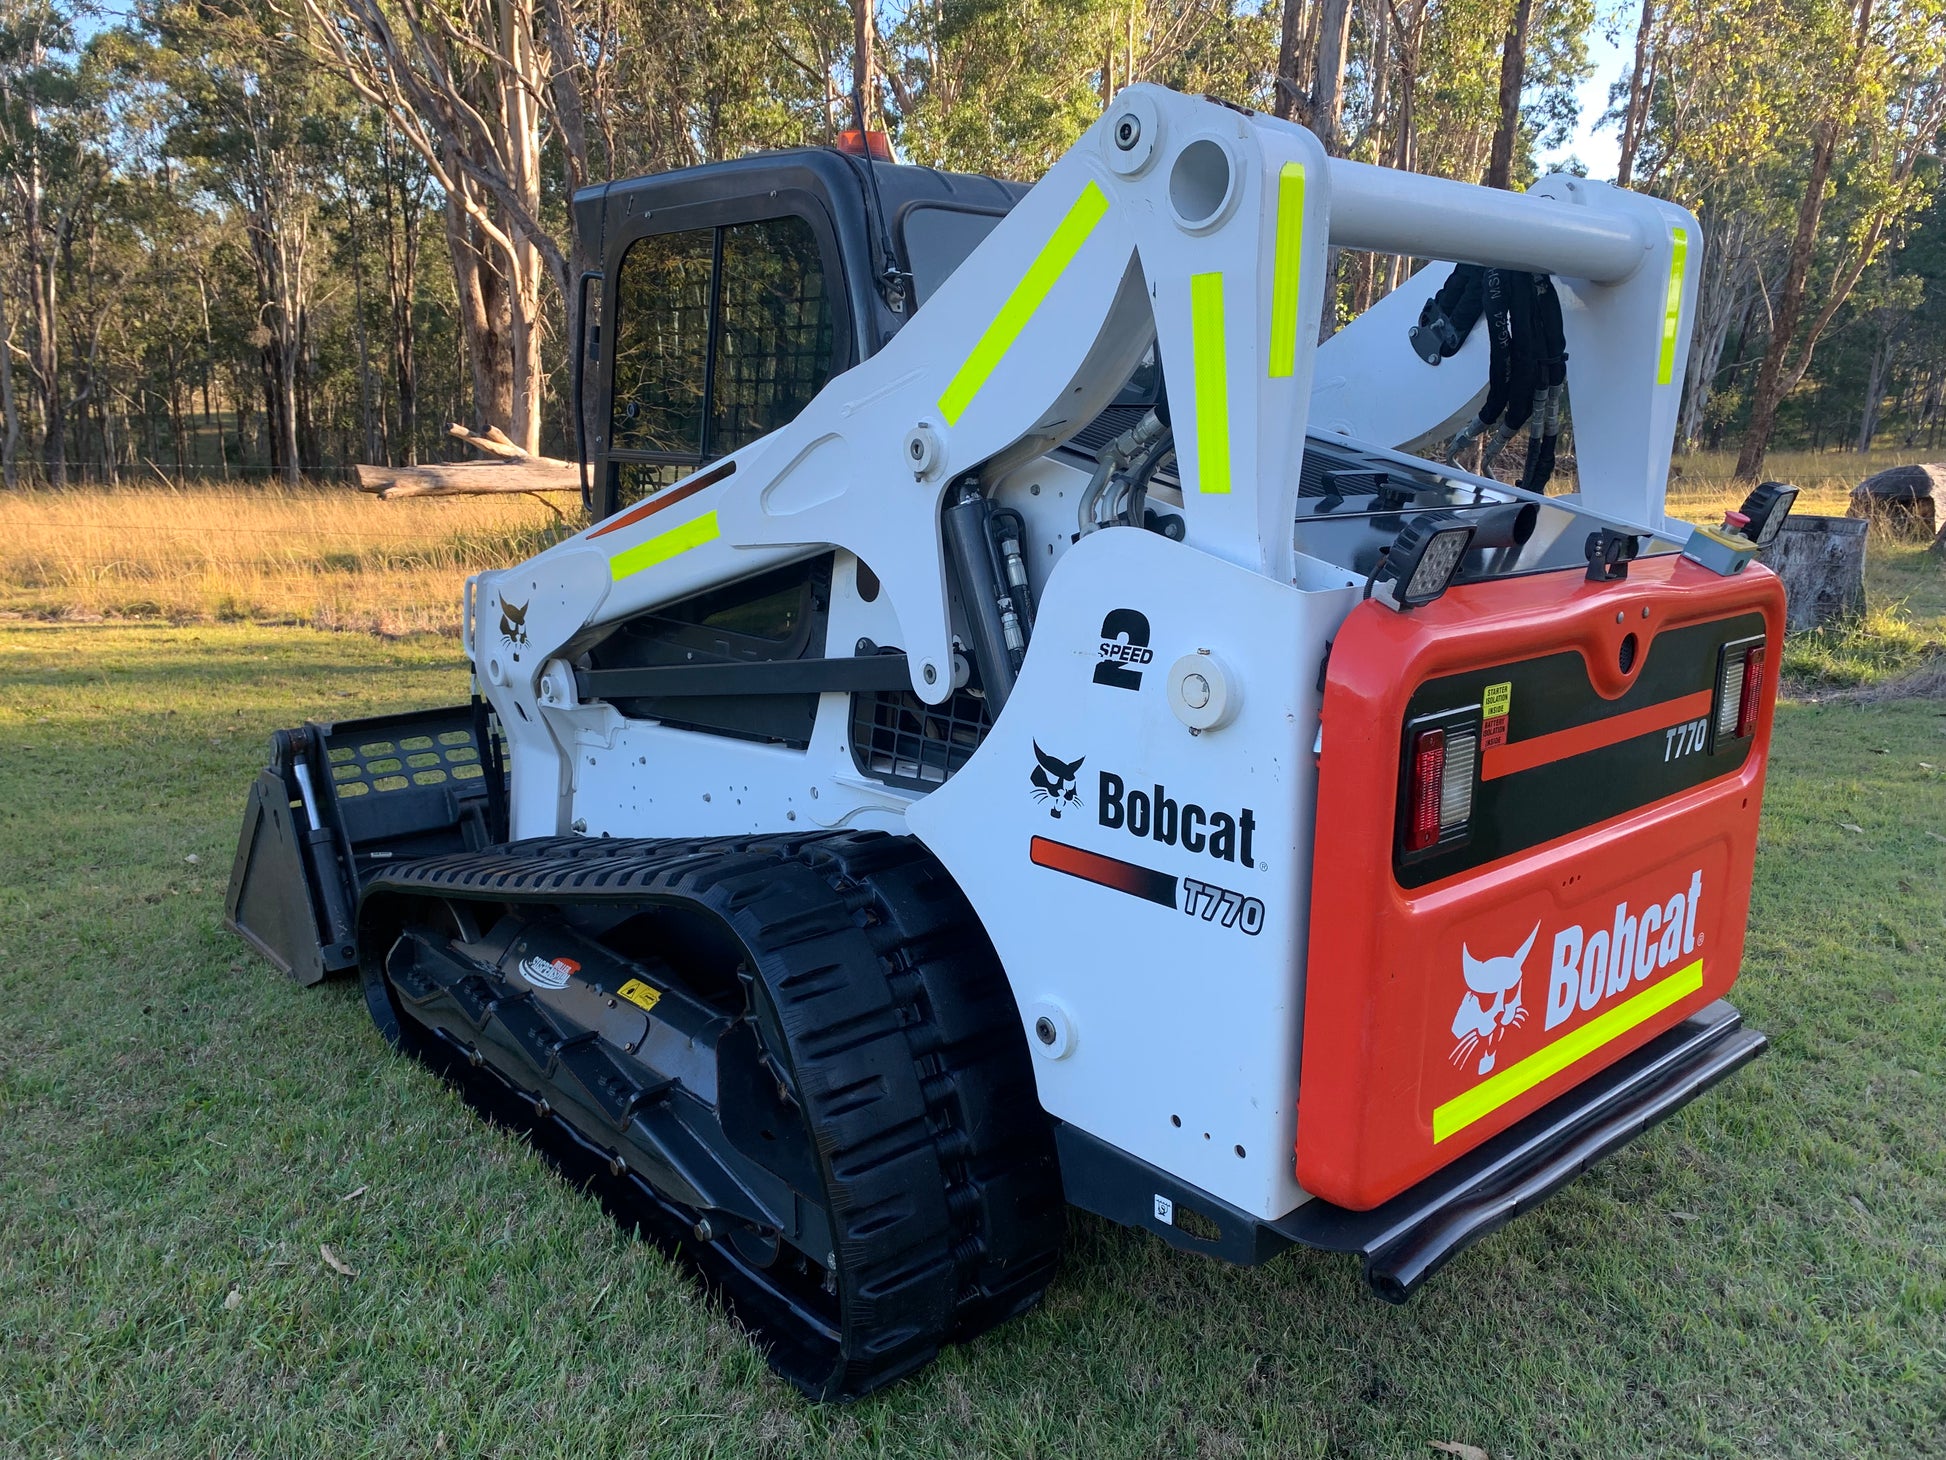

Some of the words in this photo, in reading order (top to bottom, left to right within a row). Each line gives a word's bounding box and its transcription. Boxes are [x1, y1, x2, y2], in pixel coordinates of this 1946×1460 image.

[1093, 608, 1151, 691] 2
[1098, 642, 1154, 665] SPEED
[1485, 694, 1508, 705] ISOLATION
[1487, 685, 1508, 697] STARTER
[1487, 704, 1505, 716] INSIDE
[1482, 726, 1506, 738] ISOLATION
[1484, 717, 1506, 729] BATTERY
[1664, 718, 1708, 763] T770
[1099, 770, 1256, 869] Bobcat
[1184, 878, 1266, 937] T770
[1544, 869, 1703, 1033] Bobcat
